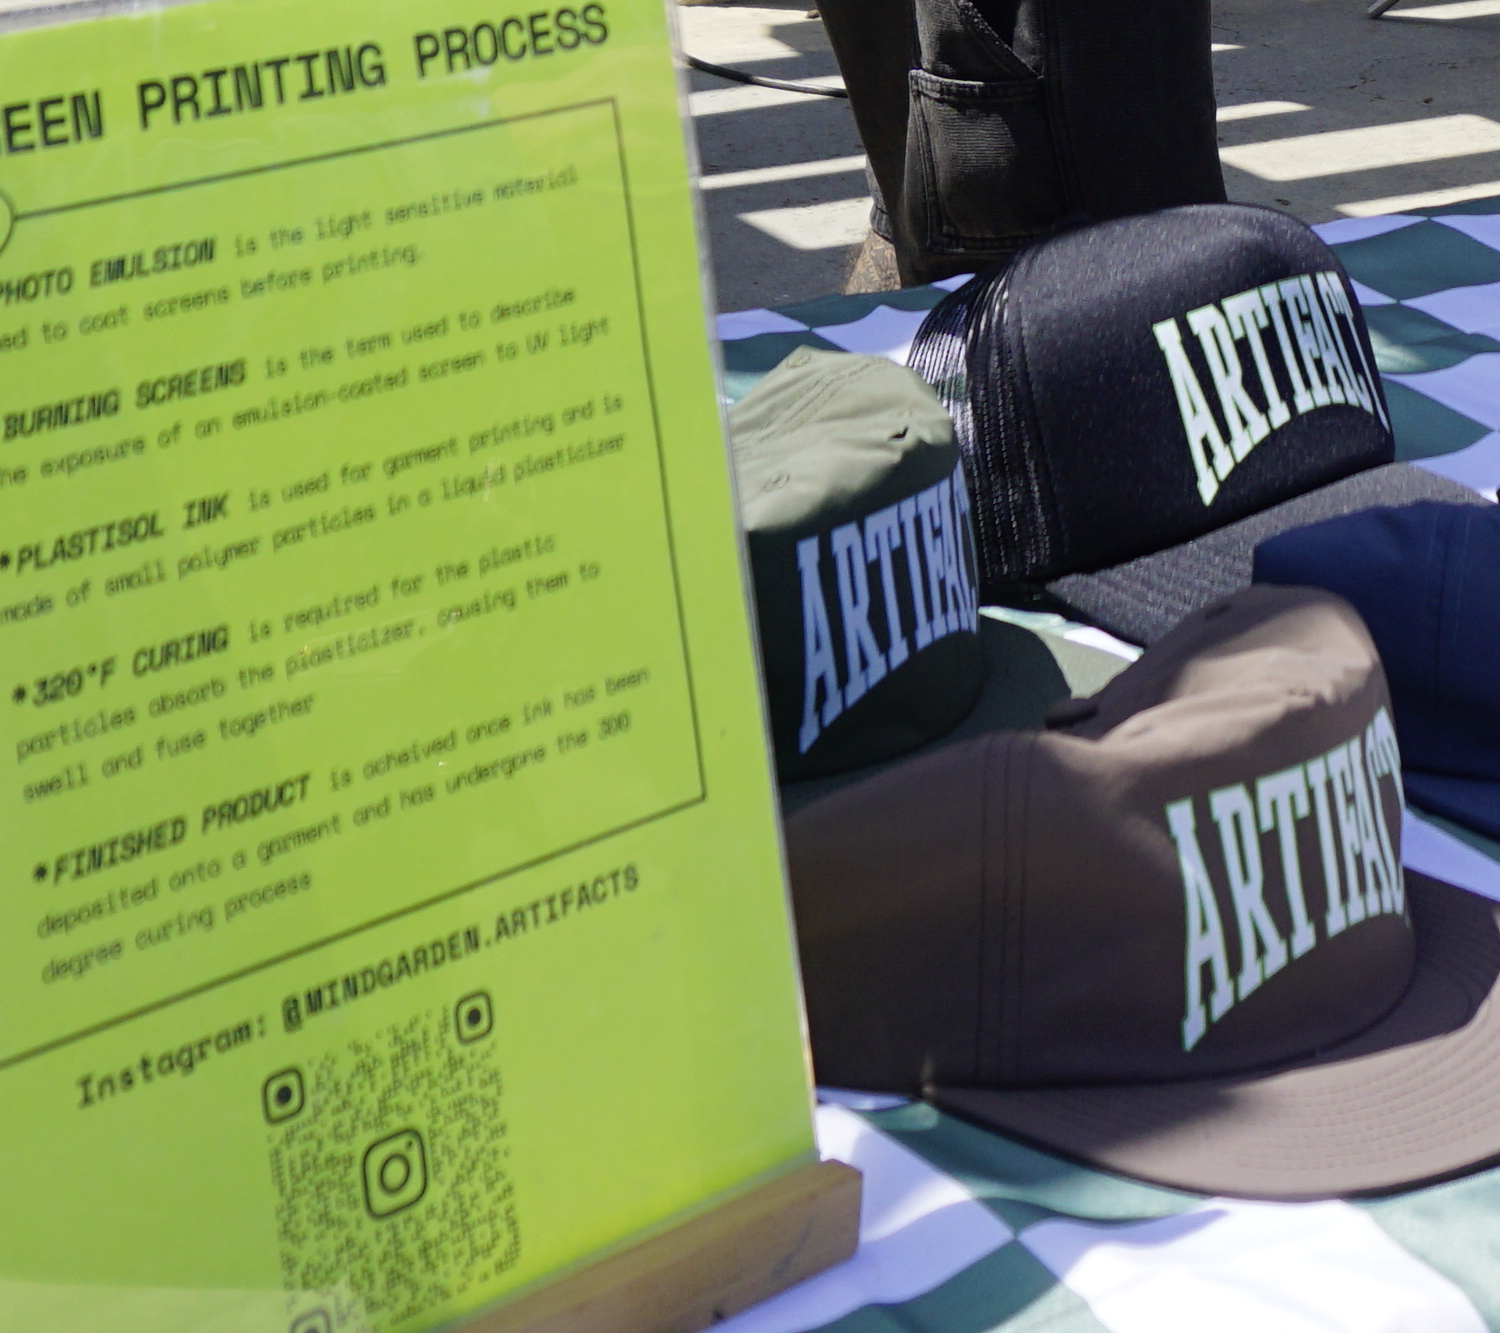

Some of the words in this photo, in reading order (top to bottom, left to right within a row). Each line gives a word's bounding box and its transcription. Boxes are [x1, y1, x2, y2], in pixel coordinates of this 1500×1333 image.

[135, 41, 387, 131] PRINTING
[411, 1, 609, 78] PROCESS
[40, 320, 69, 344] to
[77, 304, 129, 336] coat
[142, 284, 232, 321] screens
[239, 266, 313, 299] before
[88, 235, 217, 289] EMULSION
[234, 234, 259, 258] is
[268, 226, 305, 249] the
[315, 210, 371, 240] light
[384, 188, 485, 225] sensitive
[39, 435, 147, 479] exposure
[156, 419, 182, 449] of
[193, 416, 222, 440] an
[417, 349, 487, 383] screen
[494, 341, 519, 362] to
[558, 316, 609, 347] light
[134, 356, 248, 410] SCREENS
[264, 356, 288, 379] is
[298, 345, 335, 370] the
[344, 331, 392, 359] term
[400, 315, 449, 345] used
[457, 310, 481, 331] to
[489, 287, 576, 323] describe
[15, 509, 165, 576] PLASTISOL
[180, 489, 230, 530] INK
[247, 489, 271, 512] is
[280, 470, 330, 503] used
[338, 461, 373, 484] for
[381, 436, 458, 480] garment
[467, 412, 556, 456] printing
[560, 399, 595, 426] and
[602, 394, 623, 415] is
[64, 577, 91, 608] of
[103, 557, 167, 597] small
[176, 535, 261, 581] polymer
[271, 503, 376, 553] particles
[386, 493, 411, 517] in
[416, 487, 432, 508] a
[440, 463, 508, 501] liquid
[512, 432, 625, 485] plasticizer
[15, 704, 138, 765] particles
[147, 676, 227, 718] absorb
[236, 662, 275, 690] the
[436, 586, 517, 628] causing
[524, 570, 570, 600] them
[578, 560, 601, 582] to
[130, 622, 231, 679] CURING
[248, 620, 272, 643] is
[282, 583, 381, 633] required
[389, 574, 423, 597] for
[434, 560, 470, 585] the
[477, 534, 555, 578] plastic
[22, 761, 89, 804] swell
[100, 744, 144, 778] and
[153, 728, 207, 760] fuse
[217, 692, 315, 741] together
[46, 813, 189, 887] FINISHED
[199, 770, 312, 836] PRODUCT
[329, 768, 352, 792] is
[465, 713, 512, 744] once
[522, 699, 552, 725] ink
[562, 684, 596, 709] has
[604, 667, 650, 696] been
[35, 876, 160, 939] deposited
[167, 857, 223, 892] onto
[230, 848, 248, 871] a
[255, 813, 341, 867] garment
[352, 795, 392, 827] and
[398, 783, 436, 810] has
[444, 744, 547, 795] undergone
[556, 729, 589, 754] the
[40, 937, 125, 985] degree
[134, 904, 216, 951] curing
[223, 870, 312, 923] process
[75, 1014, 266, 1109] Instagram:
[280, 863, 639, 1034] @MINDGARDEN.ARTIFACTS
